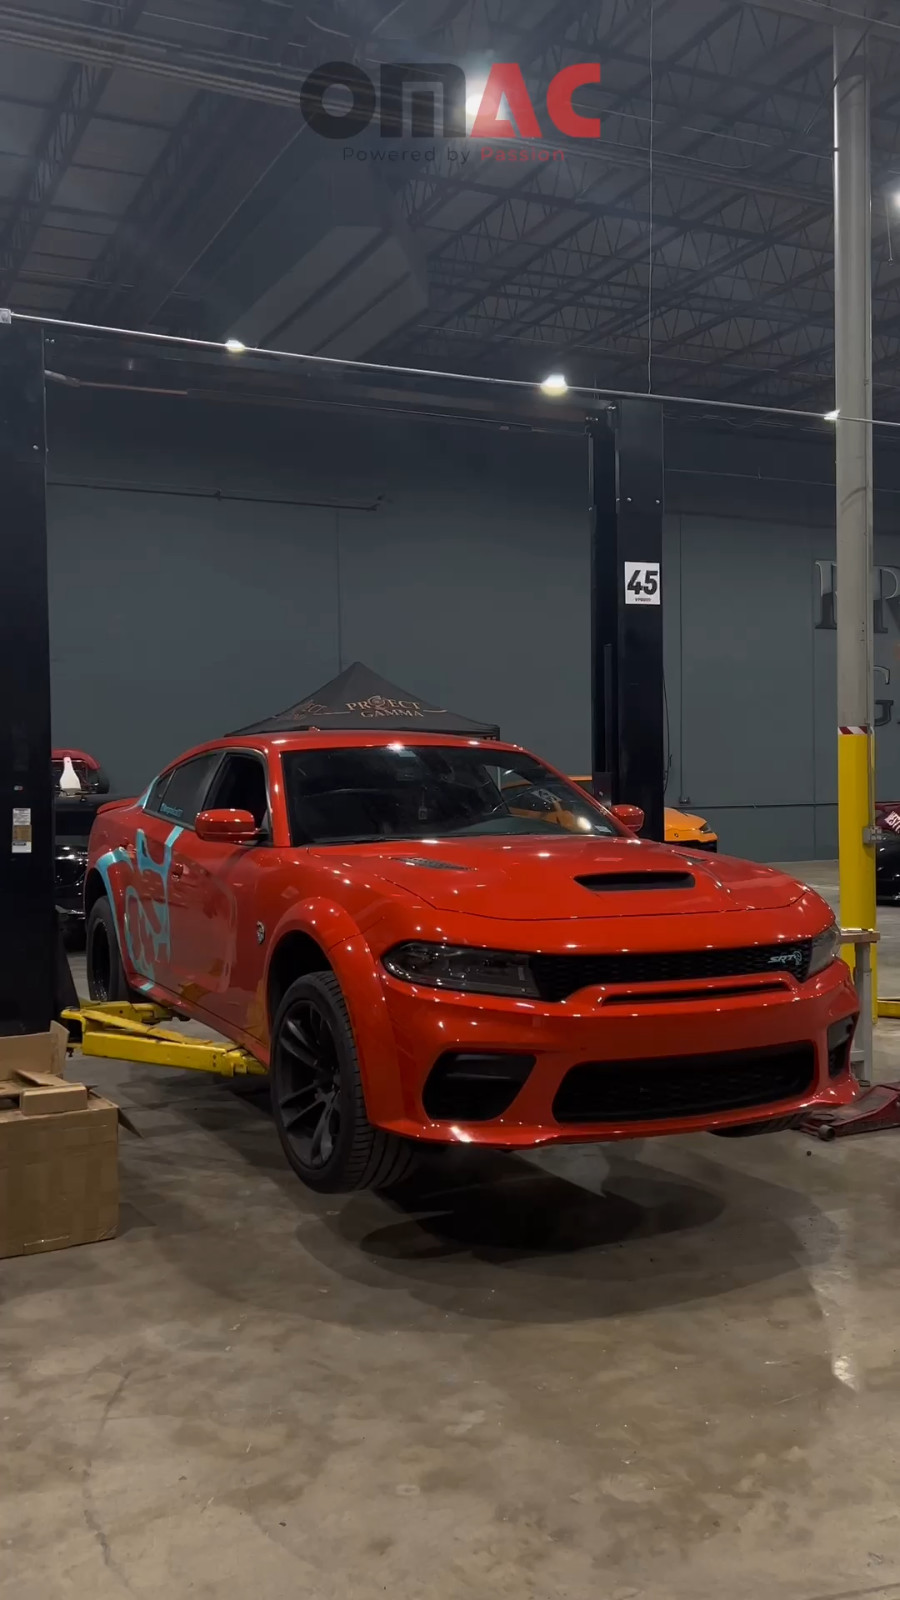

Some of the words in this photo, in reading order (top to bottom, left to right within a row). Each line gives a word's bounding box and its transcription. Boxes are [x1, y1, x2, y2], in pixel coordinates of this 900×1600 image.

[627, 569, 659, 596] 45
[360, 709, 424, 718] GAMMA
[768, 954, 795, 964] SRT
